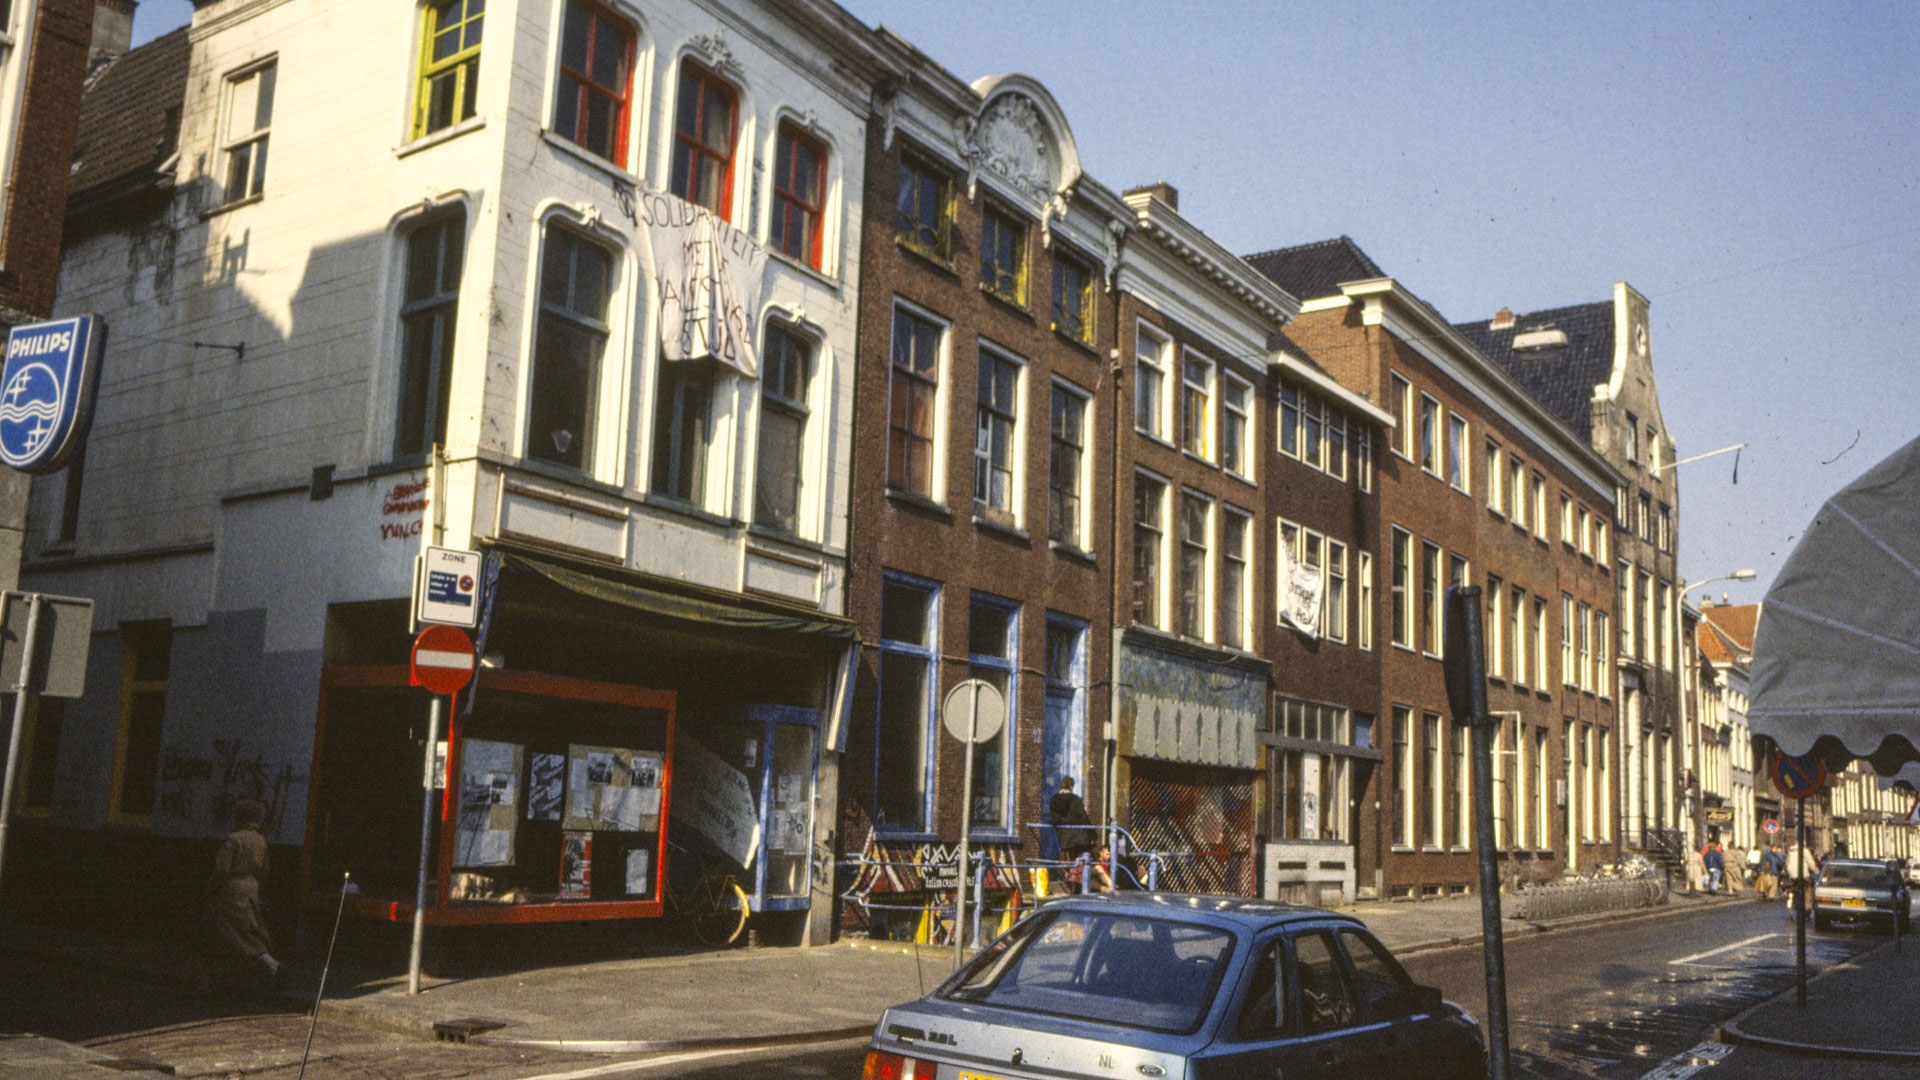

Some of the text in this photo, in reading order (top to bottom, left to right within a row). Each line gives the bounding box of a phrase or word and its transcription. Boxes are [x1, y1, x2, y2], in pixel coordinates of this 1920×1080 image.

[9, 330, 72, 359] PHILIPS
[442, 552, 467, 564] ZONE
[1099, 1054, 1115, 1069] NL
